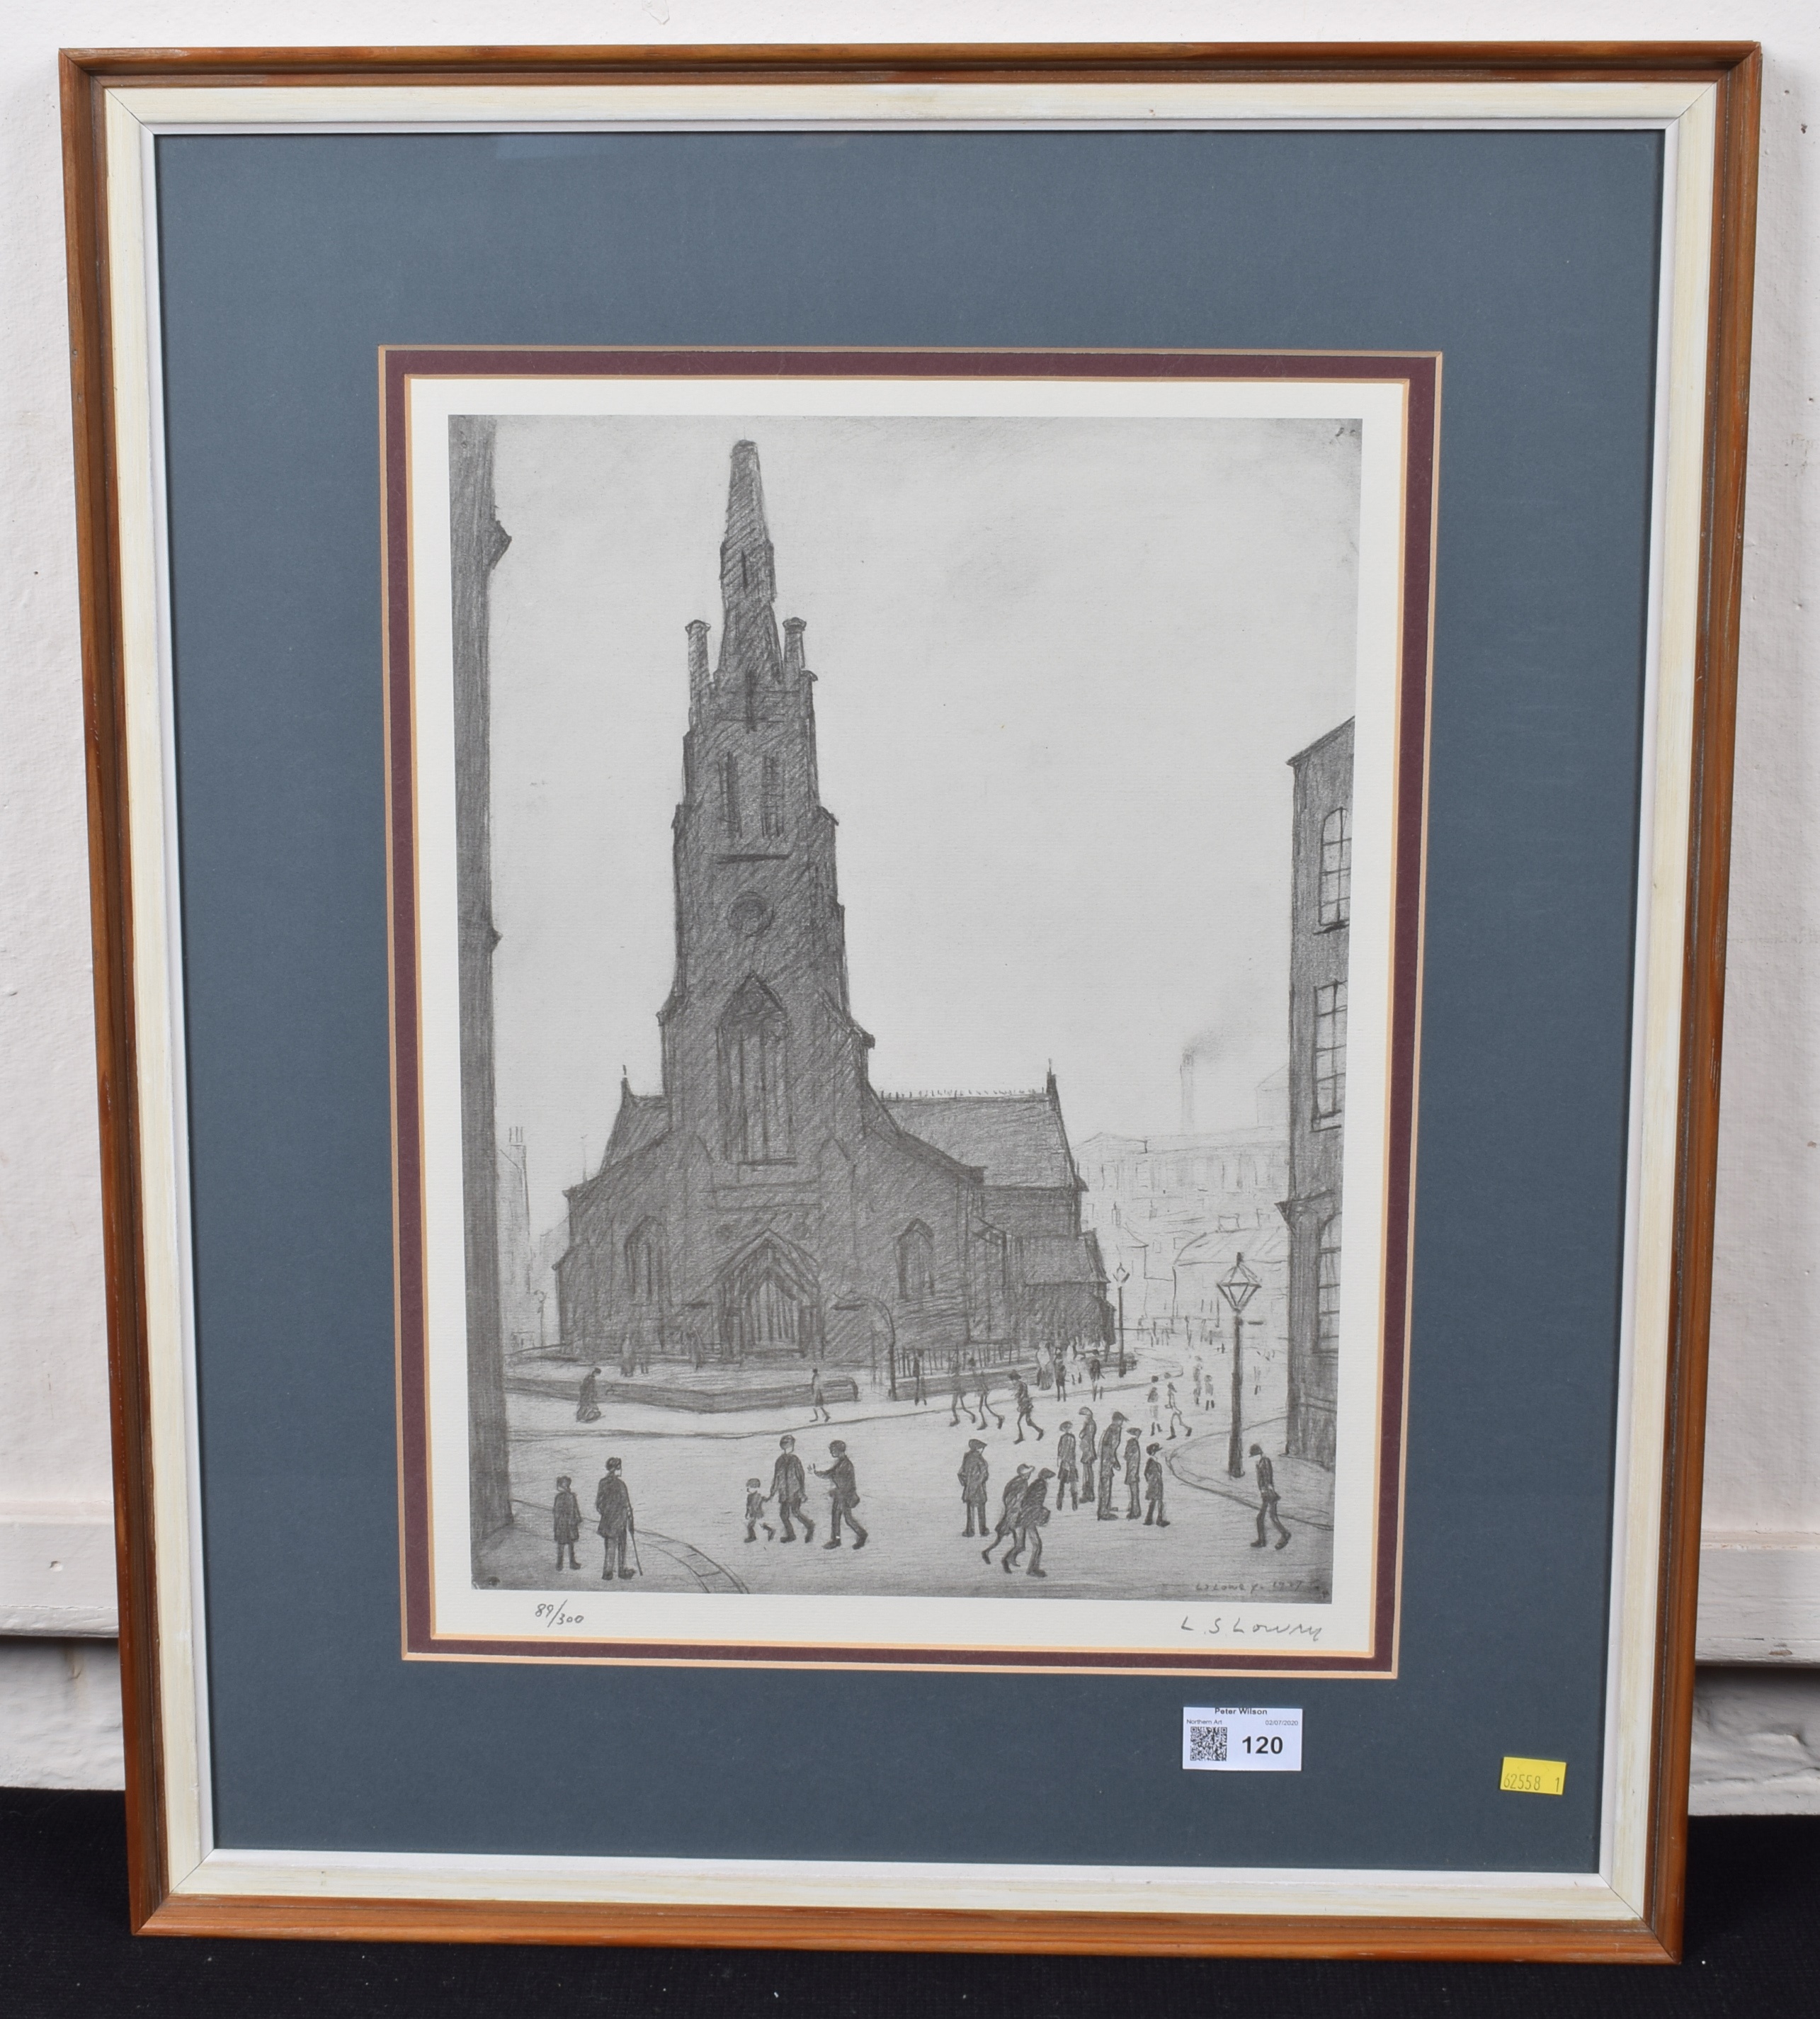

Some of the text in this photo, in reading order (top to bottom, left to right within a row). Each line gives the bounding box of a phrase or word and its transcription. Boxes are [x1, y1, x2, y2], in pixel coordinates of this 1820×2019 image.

[535, 1599, 584, 1627] 89/300
[1242, 1736, 1283, 1754] 120
[1503, 1773, 1559, 1792] 62558 1
